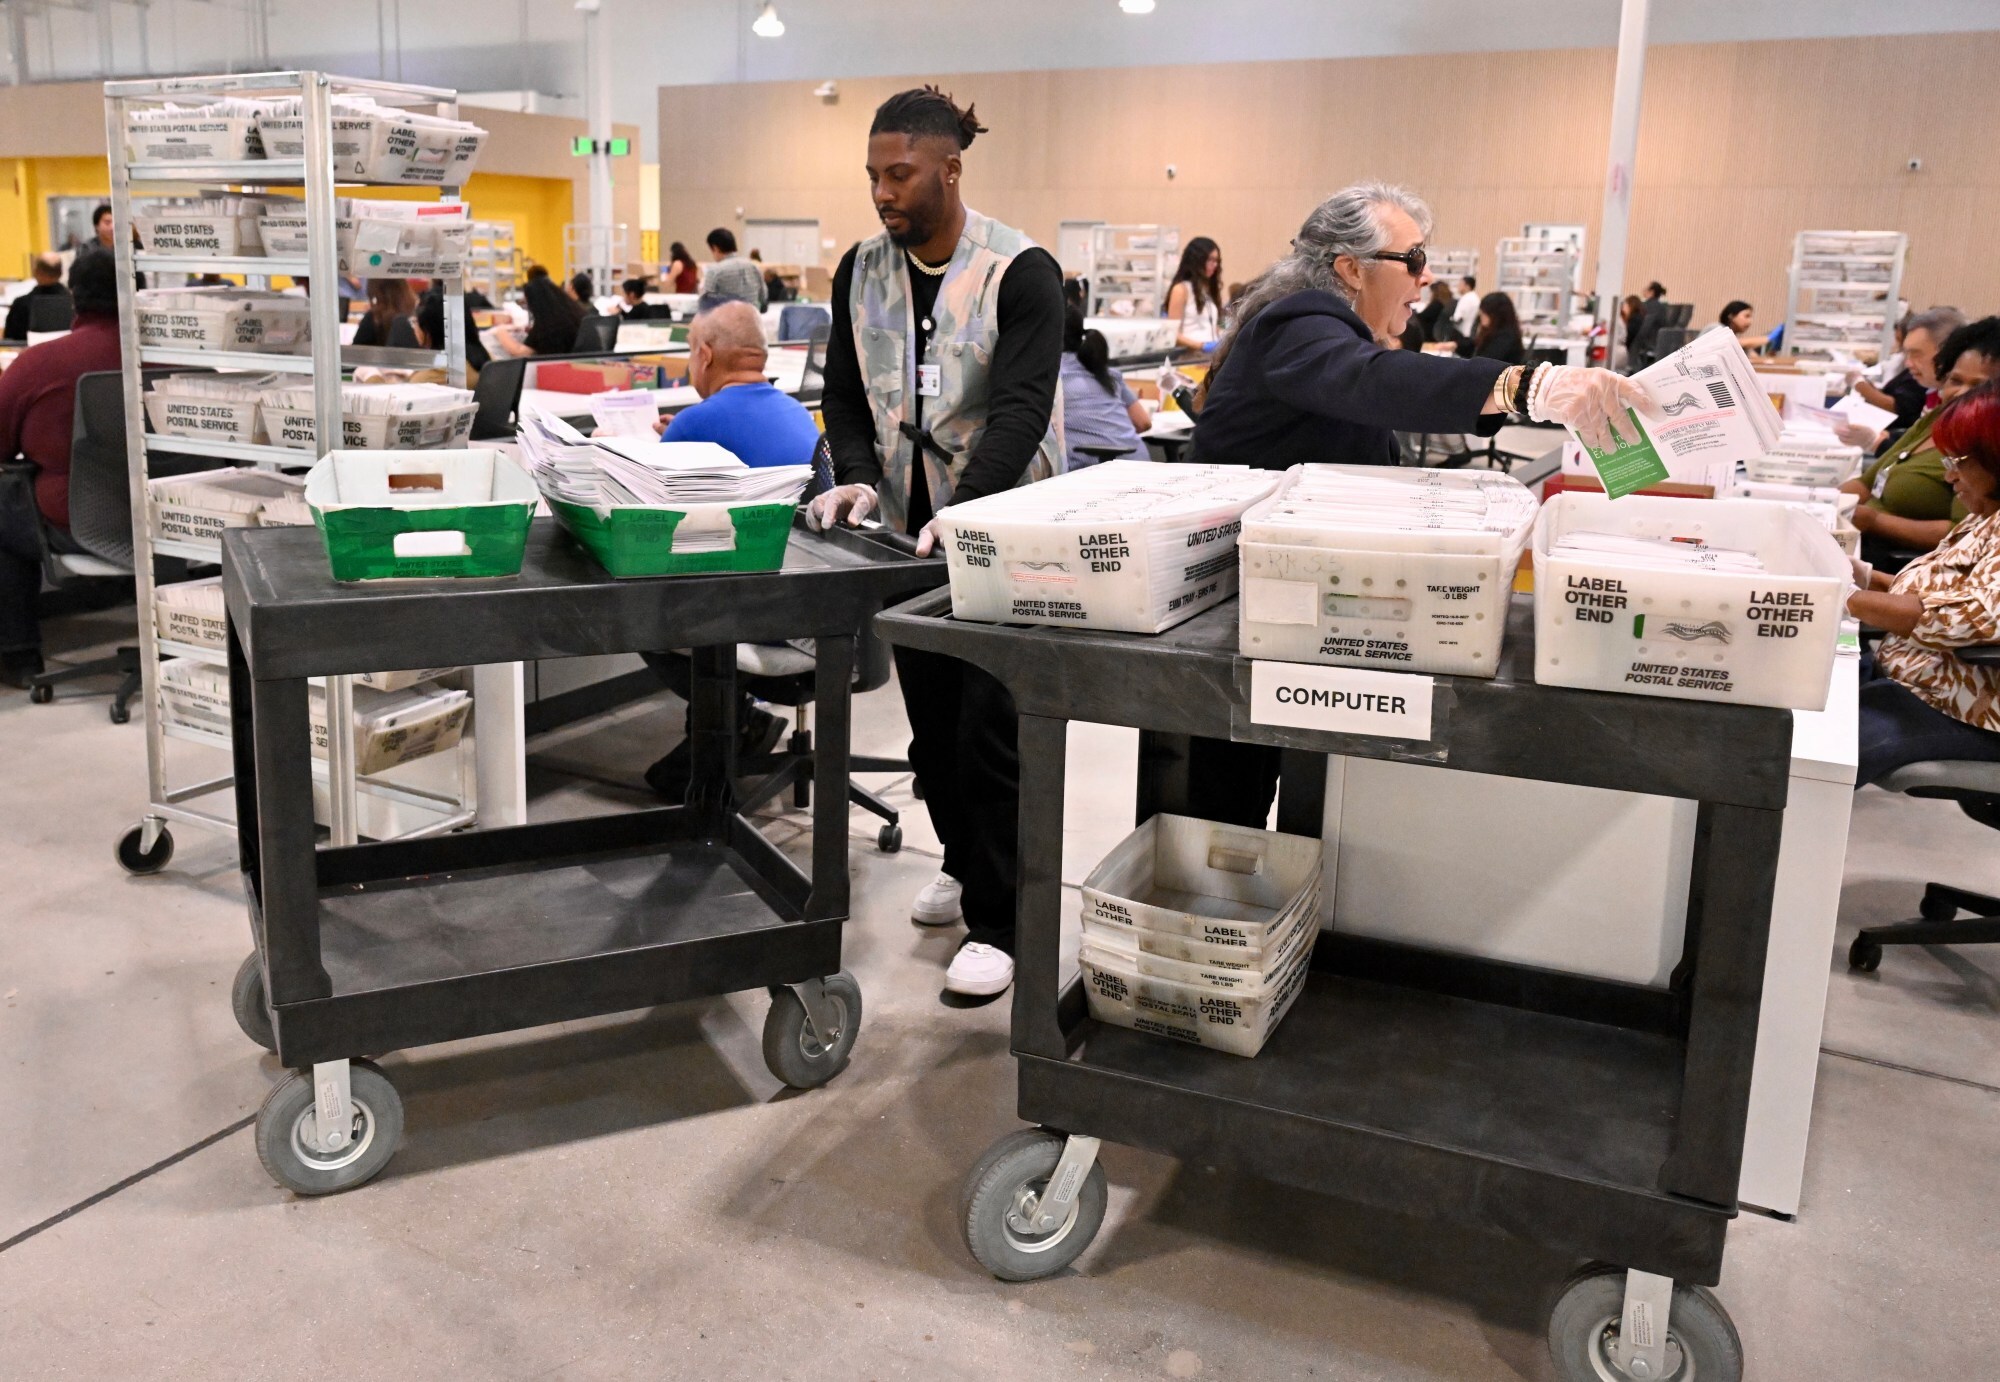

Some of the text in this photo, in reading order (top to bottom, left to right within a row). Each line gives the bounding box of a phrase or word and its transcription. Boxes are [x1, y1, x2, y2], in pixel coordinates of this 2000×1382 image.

[128, 125, 149, 133] UNITED
[199, 124, 228, 132] SERVICE
[261, 121, 303, 129] UNITED STATE
[339, 121, 372, 131] SERVICE
[391, 127, 416, 139] LABEL
[387, 137, 415, 148] OTHER
[458, 136, 478, 144] LABEL
[389, 147, 406, 156] END
[455, 145, 476, 153] OTHER
[455, 153, 469, 161] END
[154, 224, 214, 235] UNITED STATES
[153, 238, 219, 249] POSTAL SERVICE
[140, 314, 199, 326] UNITED STATES
[140, 327, 206, 341] POSTAL SERVICE
[235, 327, 263, 335] OTHER
[167, 404, 233, 418] UNITED STATES
[166, 416, 239, 431] POSTAL SERVICE
[284, 416, 315, 428] UNITE
[401, 420, 422, 428] LABEL
[1688, 422, 1705, 431] REPLY
[1705, 419, 1718, 427] MAIL
[282, 429, 315, 442] POSTA
[161, 511, 225, 528] UNITED STATES
[161, 522, 222, 540] POSTAL SERVIC
[955, 528, 994, 543] LABEL
[1187, 527, 1218, 547] UNITED
[1079, 533, 1128, 546] LABEL
[957, 541, 997, 556] OTHER
[1079, 546, 1130, 559] OTHER
[966, 554, 991, 568] END
[1091, 560, 1121, 573] END
[1567, 575, 1628, 594] LABEL
[1564, 590, 1628, 610] OTHER
[1749, 590, 1815, 607] LABEL
[1013, 600, 1082, 611] UNITED STATES
[1012, 608, 1087, 620] POSTAL SERVICE
[1575, 608, 1615, 625] END
[1746, 606, 1815, 623] OTHER
[170, 612, 226, 631] UNITED STATE
[170, 624, 199, 637] POSTAL
[203, 630, 225, 641] SERV
[1757, 624, 1799, 639] END
[1323, 638, 1409, 651] UNITED STATES
[1319, 646, 1413, 662] POSTAL SERVICE
[1631, 662, 1730, 682] UNITED STATES
[1624, 672, 1734, 694] POSTAL SERVICE
[177, 688, 197, 700] STATES
[198, 694, 219, 705] POSTAL
[1275, 686, 1407, 715] COMPUTER
[1095, 899, 1132, 917] LABEL
[1095, 910, 1133, 926] OTHER
[1204, 926, 1246, 938] LABEL
[1204, 936, 1247, 947] OTHER
[1092, 968, 1127, 987] LABEL
[1092, 977, 1128, 996] OTHER
[1100, 988, 1123, 1001] END
[1200, 997, 1240, 1010] LABEL
[1171, 1007, 1197, 1019] SERVI
[1200, 1006, 1242, 1018] OTHER
[1135, 1017, 1198, 1037] UNITED STATES
[1208, 1015, 1235, 1026] END
[1134, 1022, 1164, 1034] POSTAL
